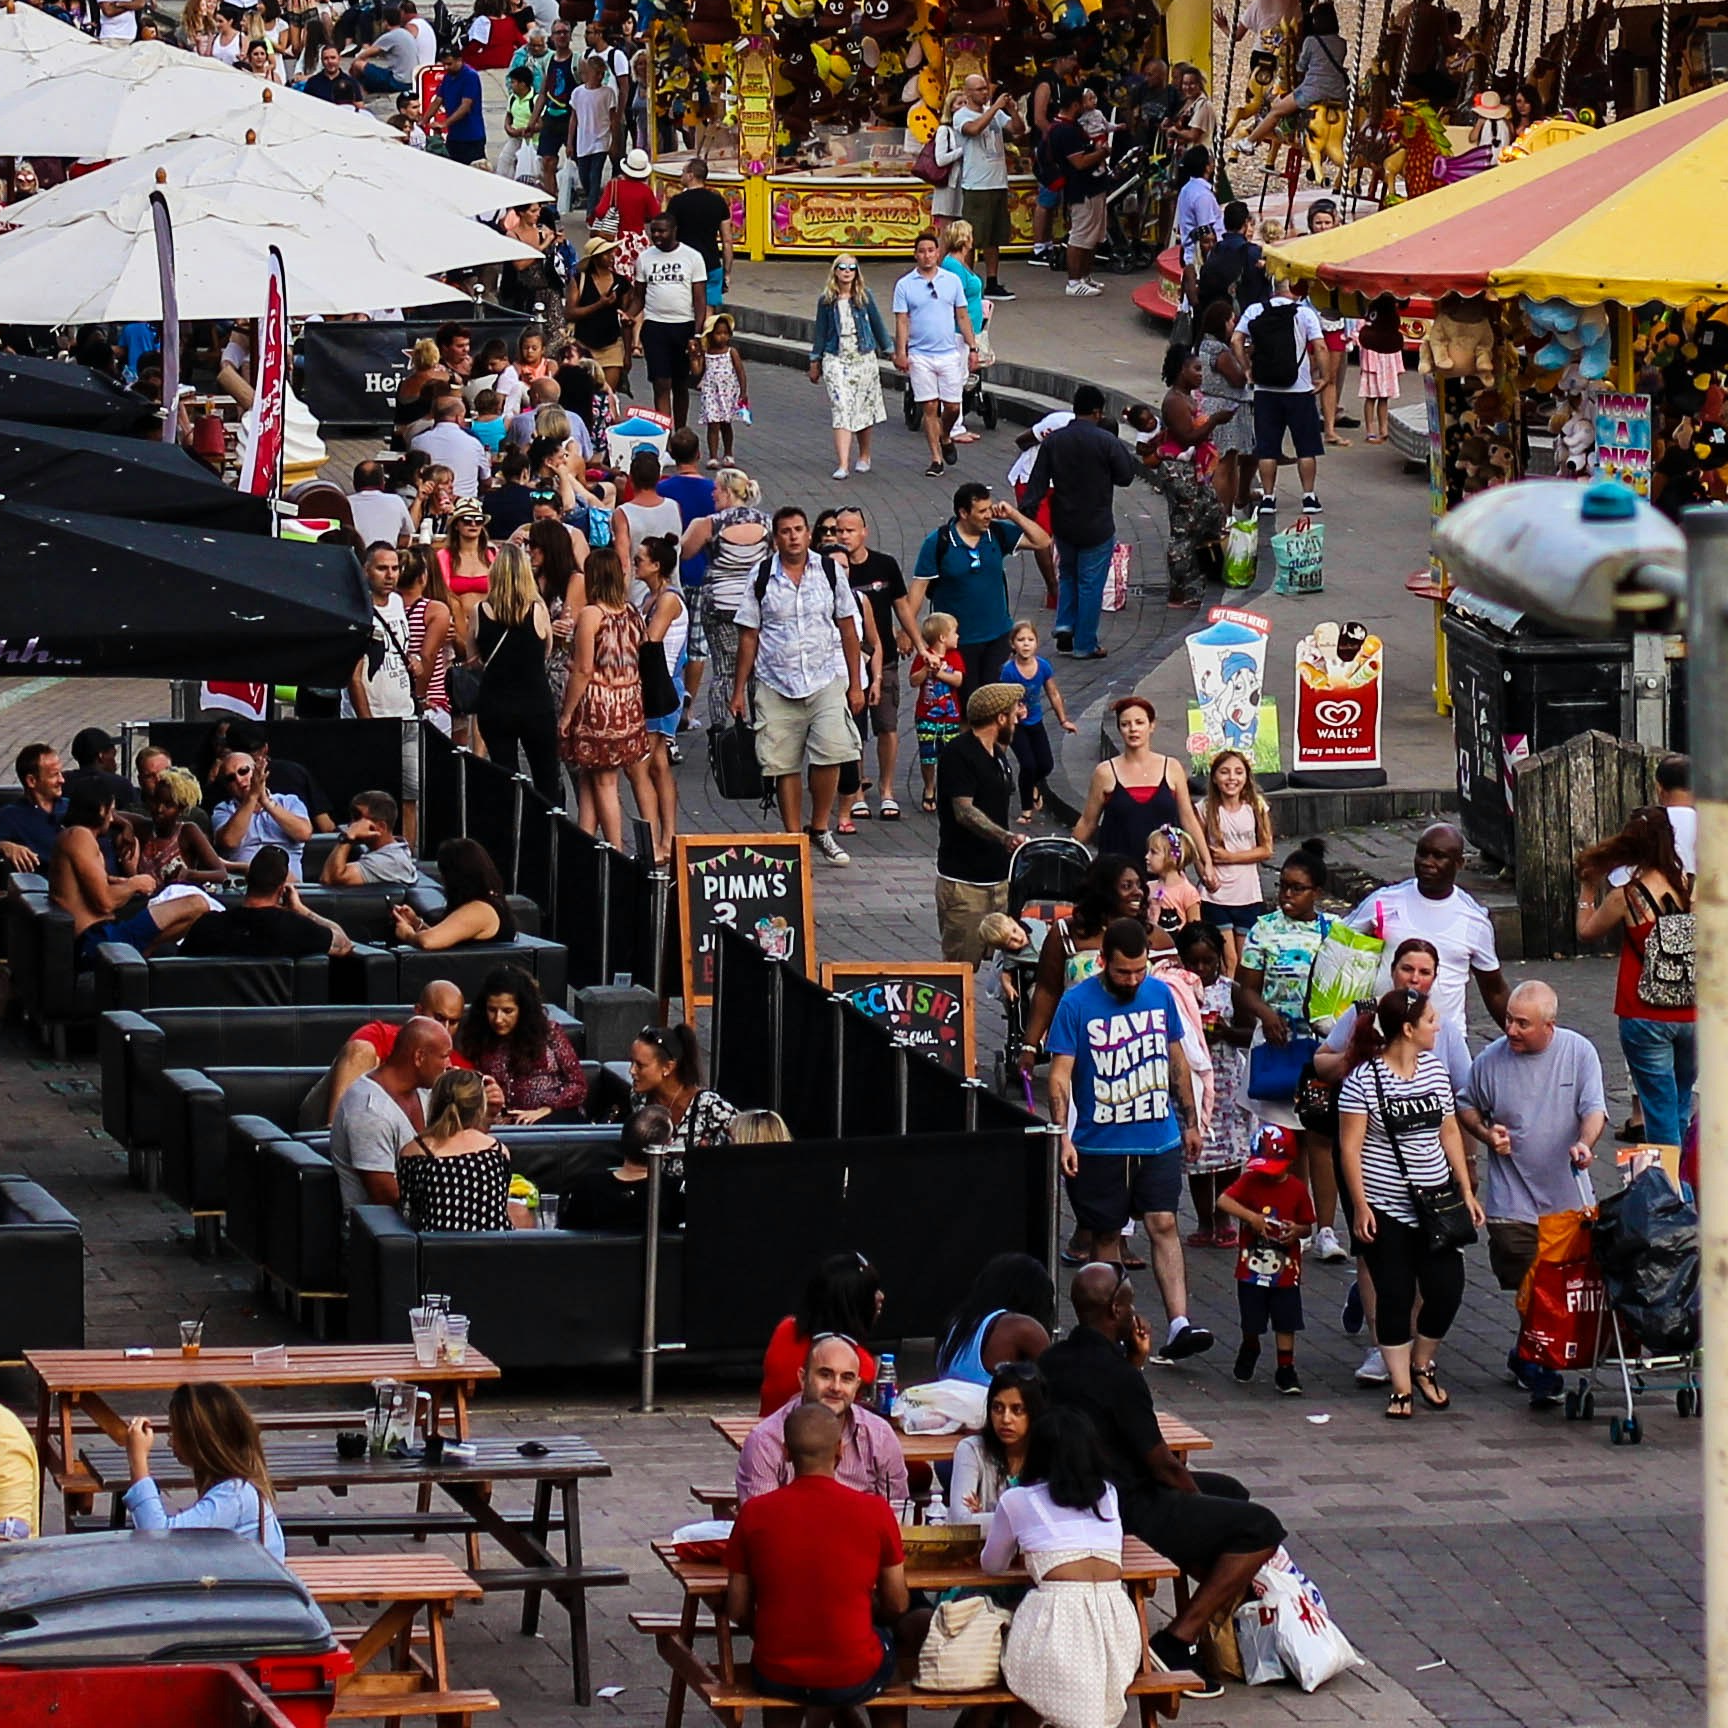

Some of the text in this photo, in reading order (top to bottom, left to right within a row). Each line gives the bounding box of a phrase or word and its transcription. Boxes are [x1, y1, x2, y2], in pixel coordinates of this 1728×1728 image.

[802, 206, 921, 225] GREAT PRIZES
[650, 262, 682, 274] Lee
[1598, 393, 1649, 419] HOOK
[1615, 420, 1631, 445] A
[1598, 446, 1651, 473] DUCK
[1316, 727, 1358, 740] WALL'S
[1301, 745, 1372, 758] Fancy an Ice Cream?
[703, 873, 788, 901] PIMM'S
[1086, 1008, 1167, 1047] SAVE
[1090, 1032, 1169, 1077] WATER
[1093, 1058, 1170, 1104] DRINK
[1092, 1090, 1170, 1124] BEER
